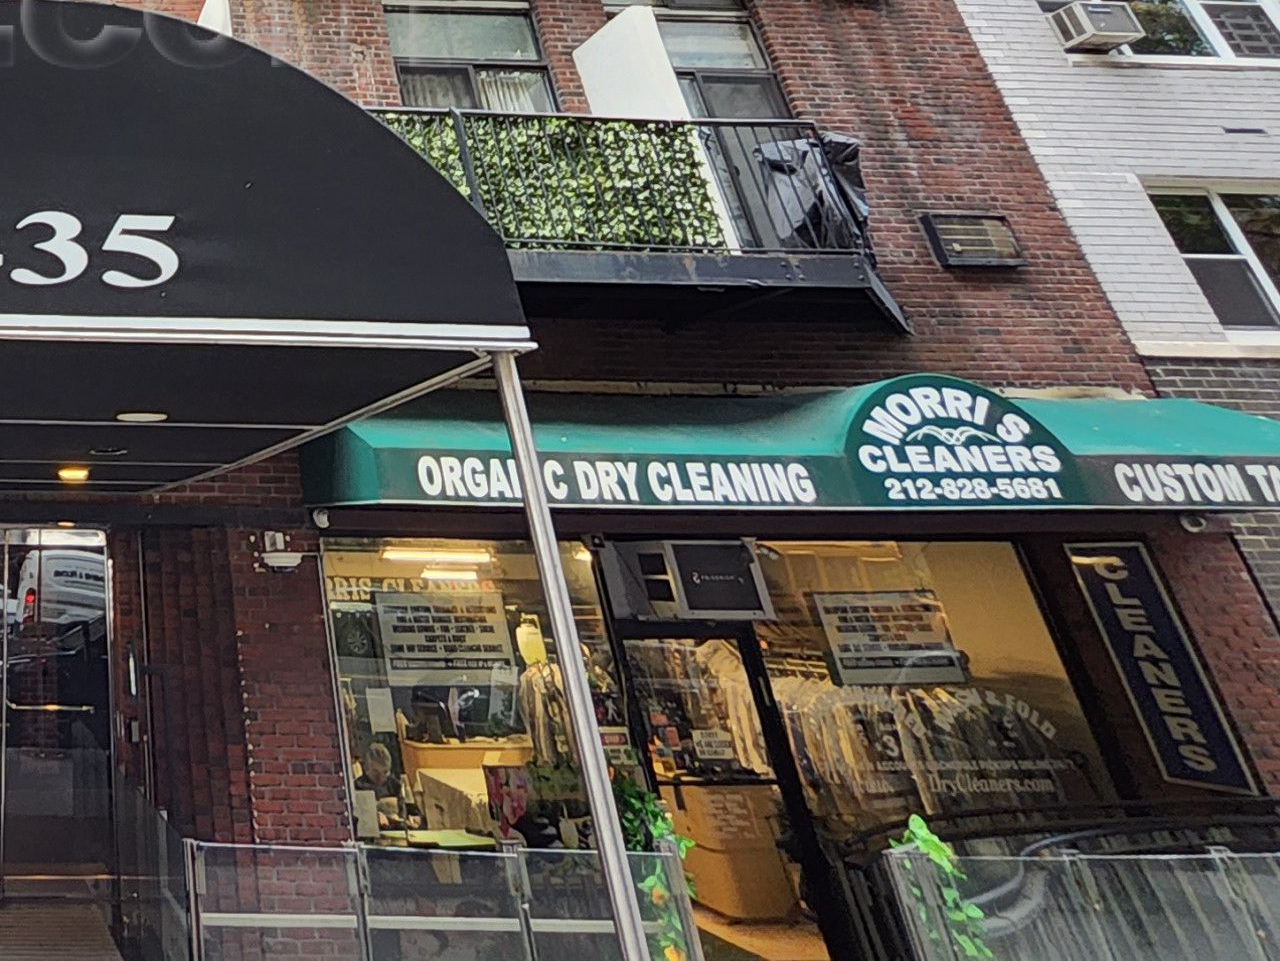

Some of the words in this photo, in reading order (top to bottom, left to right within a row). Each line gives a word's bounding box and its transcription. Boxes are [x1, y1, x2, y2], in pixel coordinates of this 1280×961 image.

[858, 444, 1062, 473] CLEANERS
[418, 455, 568, 502] ORGAC
[572, 460, 640, 501] DRY
[647, 462, 818, 503] CLEANING
[884, 478, 1063, 500] 212-828-5681
[1114, 462, 1253, 502] CUSTOM
[1092, 555, 1218, 772] CLEANERS
